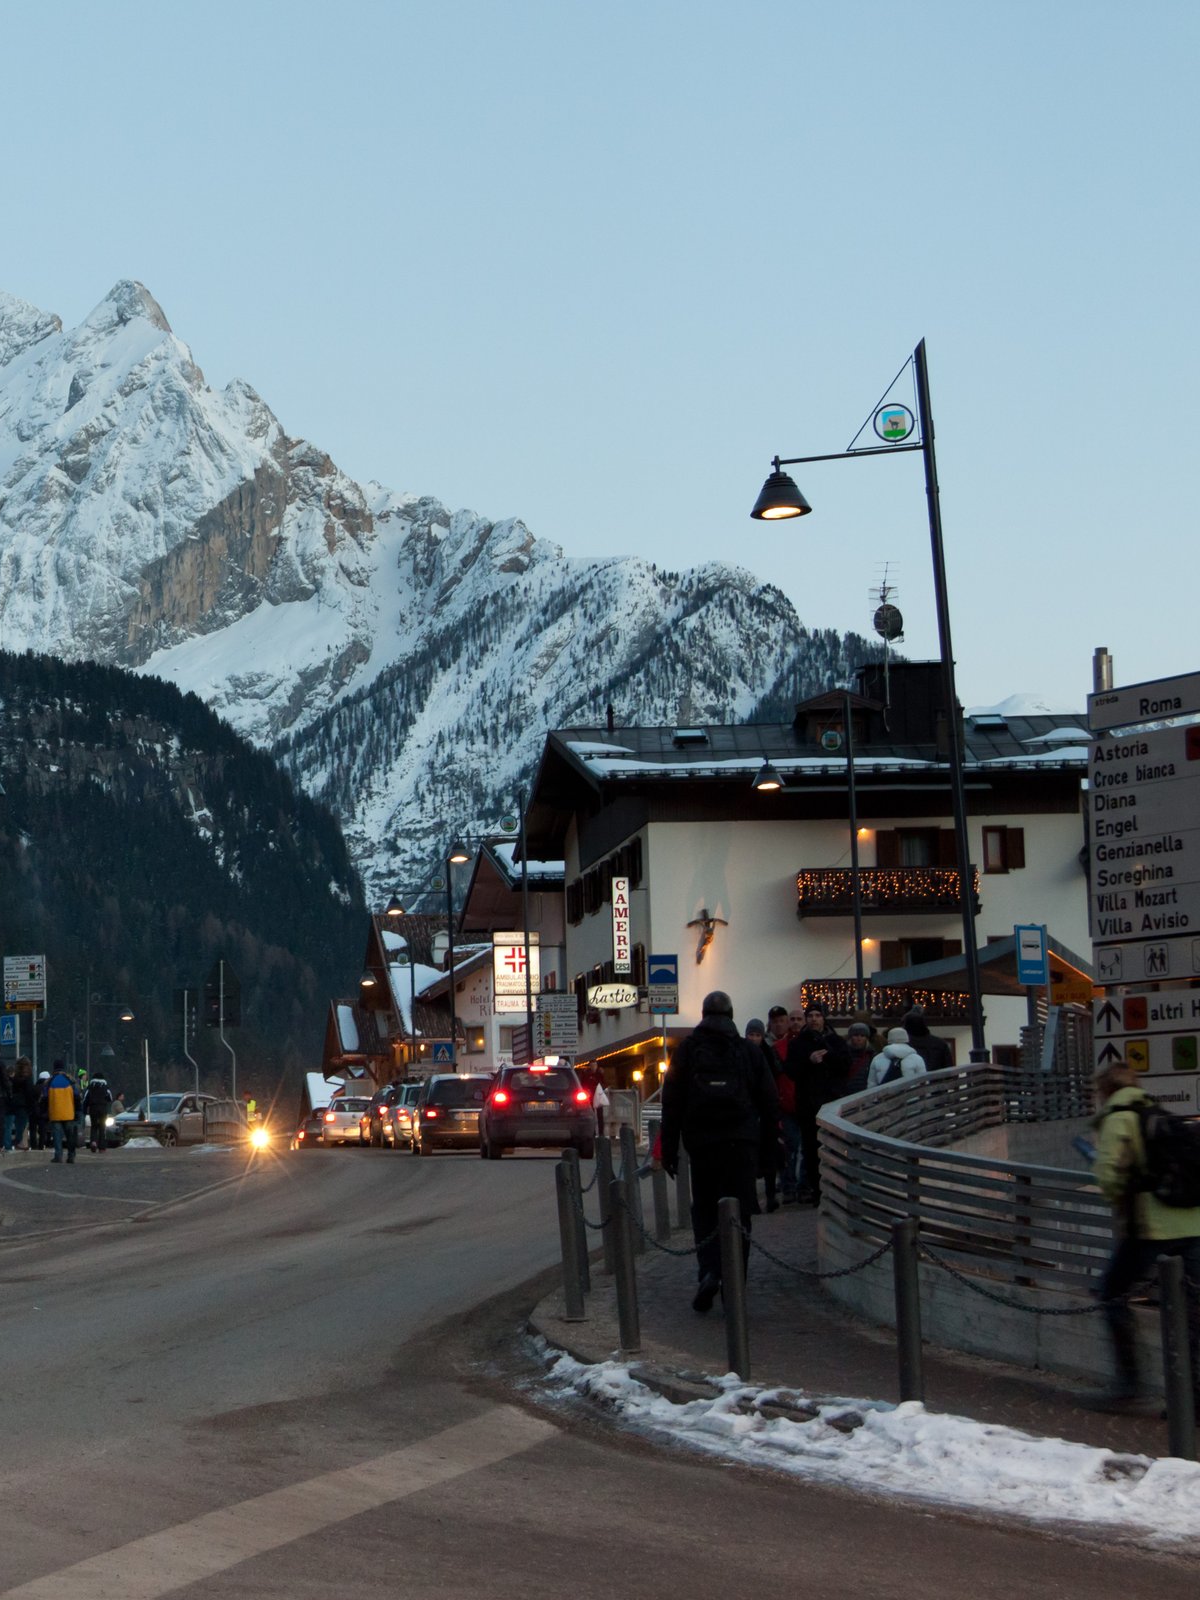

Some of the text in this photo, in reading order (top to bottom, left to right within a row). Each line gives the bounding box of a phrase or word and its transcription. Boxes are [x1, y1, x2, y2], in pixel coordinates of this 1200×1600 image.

[1140, 696, 1182, 716] Roma
[1094, 741, 1149, 763] Astoria
[1094, 763, 1176, 788] Croce bianca
[1094, 793, 1137, 812] Diana
[1095, 815, 1139, 838] Engel
[1096, 835, 1184, 862] Genzianella
[1097, 864, 1174, 887] Soreghina
[1097, 888, 1178, 913] Villa Mozart
[614, 880, 629, 960] CAMERE
[1097, 912, 1190, 936] Villa Avisio
[471, 994, 490, 1004] Hotel
[590, 986, 638, 1004] Lasties
[1151, 1003, 1184, 1021] altri
